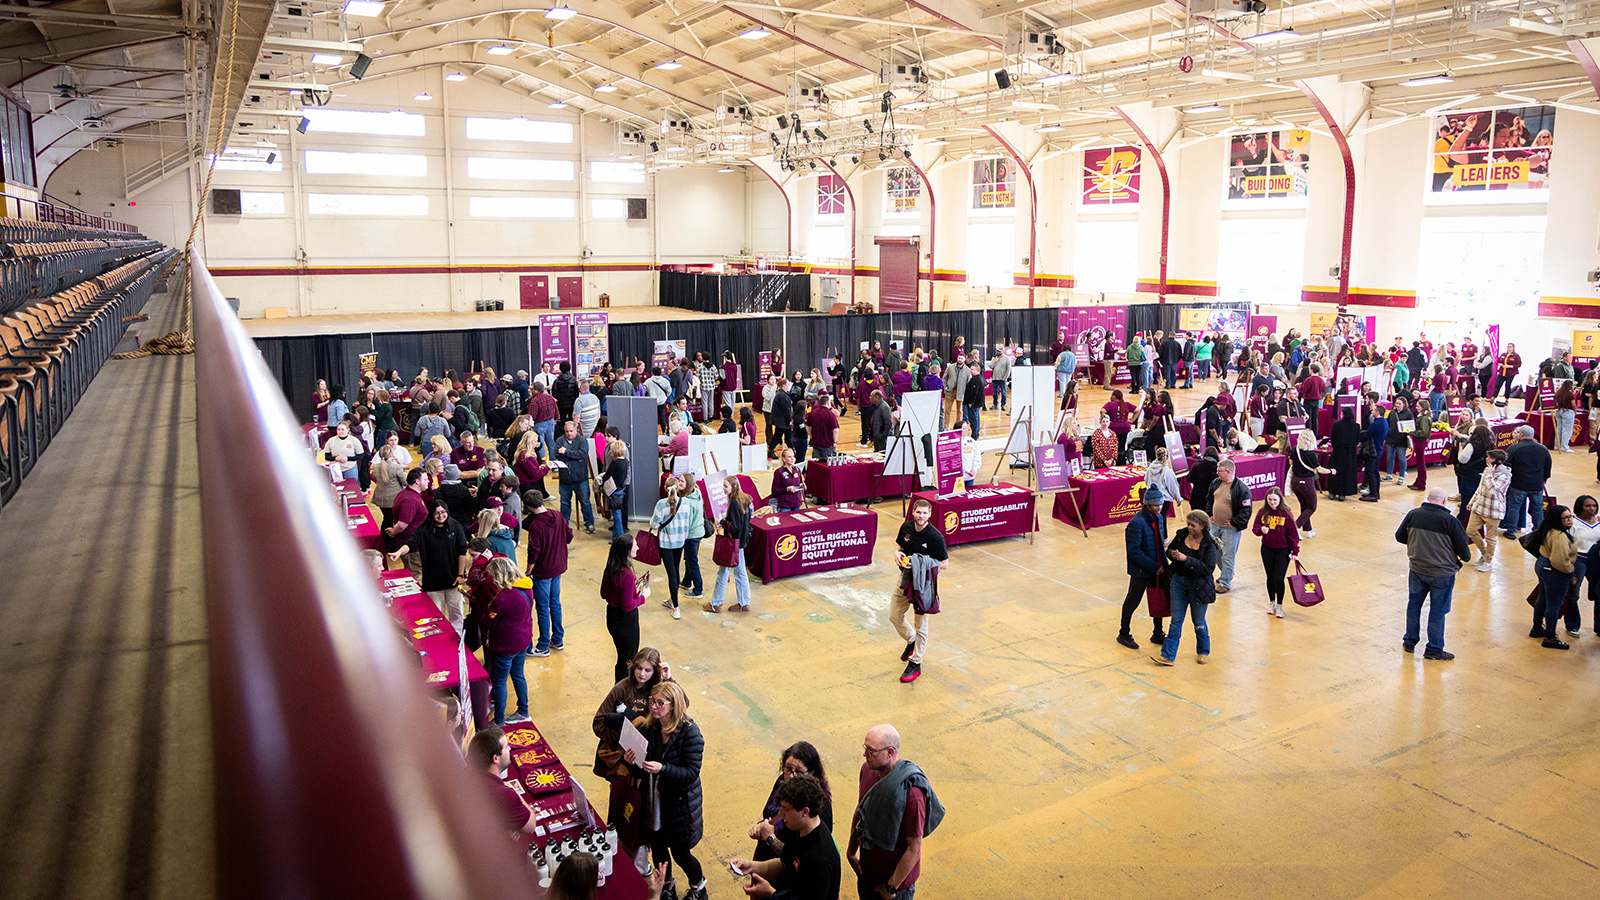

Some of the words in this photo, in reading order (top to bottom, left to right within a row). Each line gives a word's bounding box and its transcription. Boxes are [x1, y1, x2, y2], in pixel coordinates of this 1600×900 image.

[1461, 165, 1520, 181] LEADERS
[1247, 178, 1291, 190] BUILDING
[360, 355, 376, 365] CMU
[961, 508, 992, 518] STUDENT
[993, 502, 1028, 513] DISABILITY
[961, 514, 994, 524] SERVICES
[802, 534, 825, 544] CIVIL
[827, 530, 858, 540] RIGHTS
[802, 537, 868, 552] INSTITUTIONAL
[802, 549, 835, 560] EQUITY
